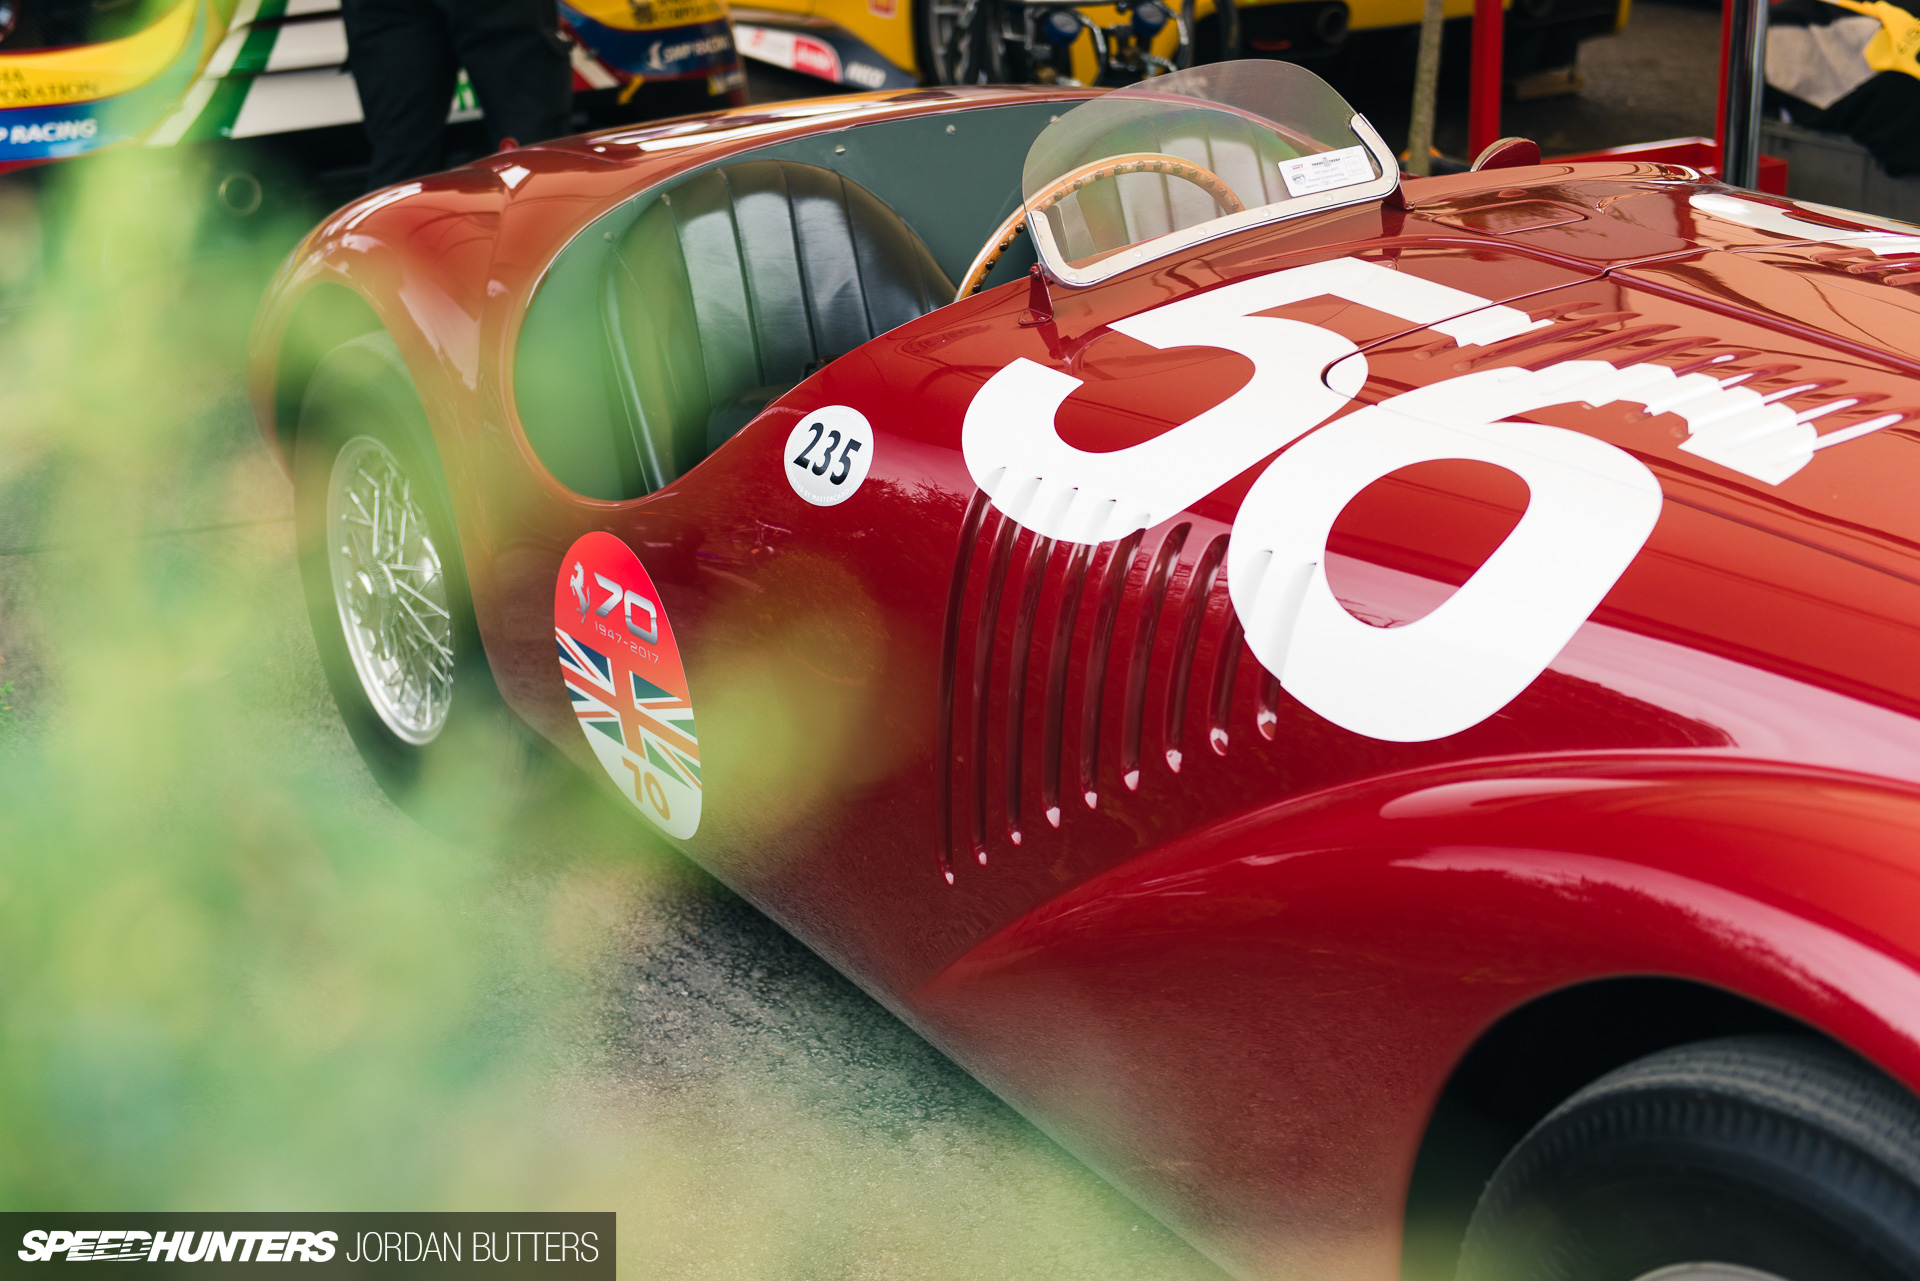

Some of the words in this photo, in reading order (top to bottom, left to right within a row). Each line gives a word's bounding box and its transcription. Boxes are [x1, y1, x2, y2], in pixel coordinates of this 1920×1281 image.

[10, 118, 98, 145] RACING
[793, 422, 862, 485] 235
[962, 257, 1816, 742] 56
[594, 572, 658, 645] 70
[594, 621, 659, 664] 1947-2017
[621, 755, 671, 821] 70
